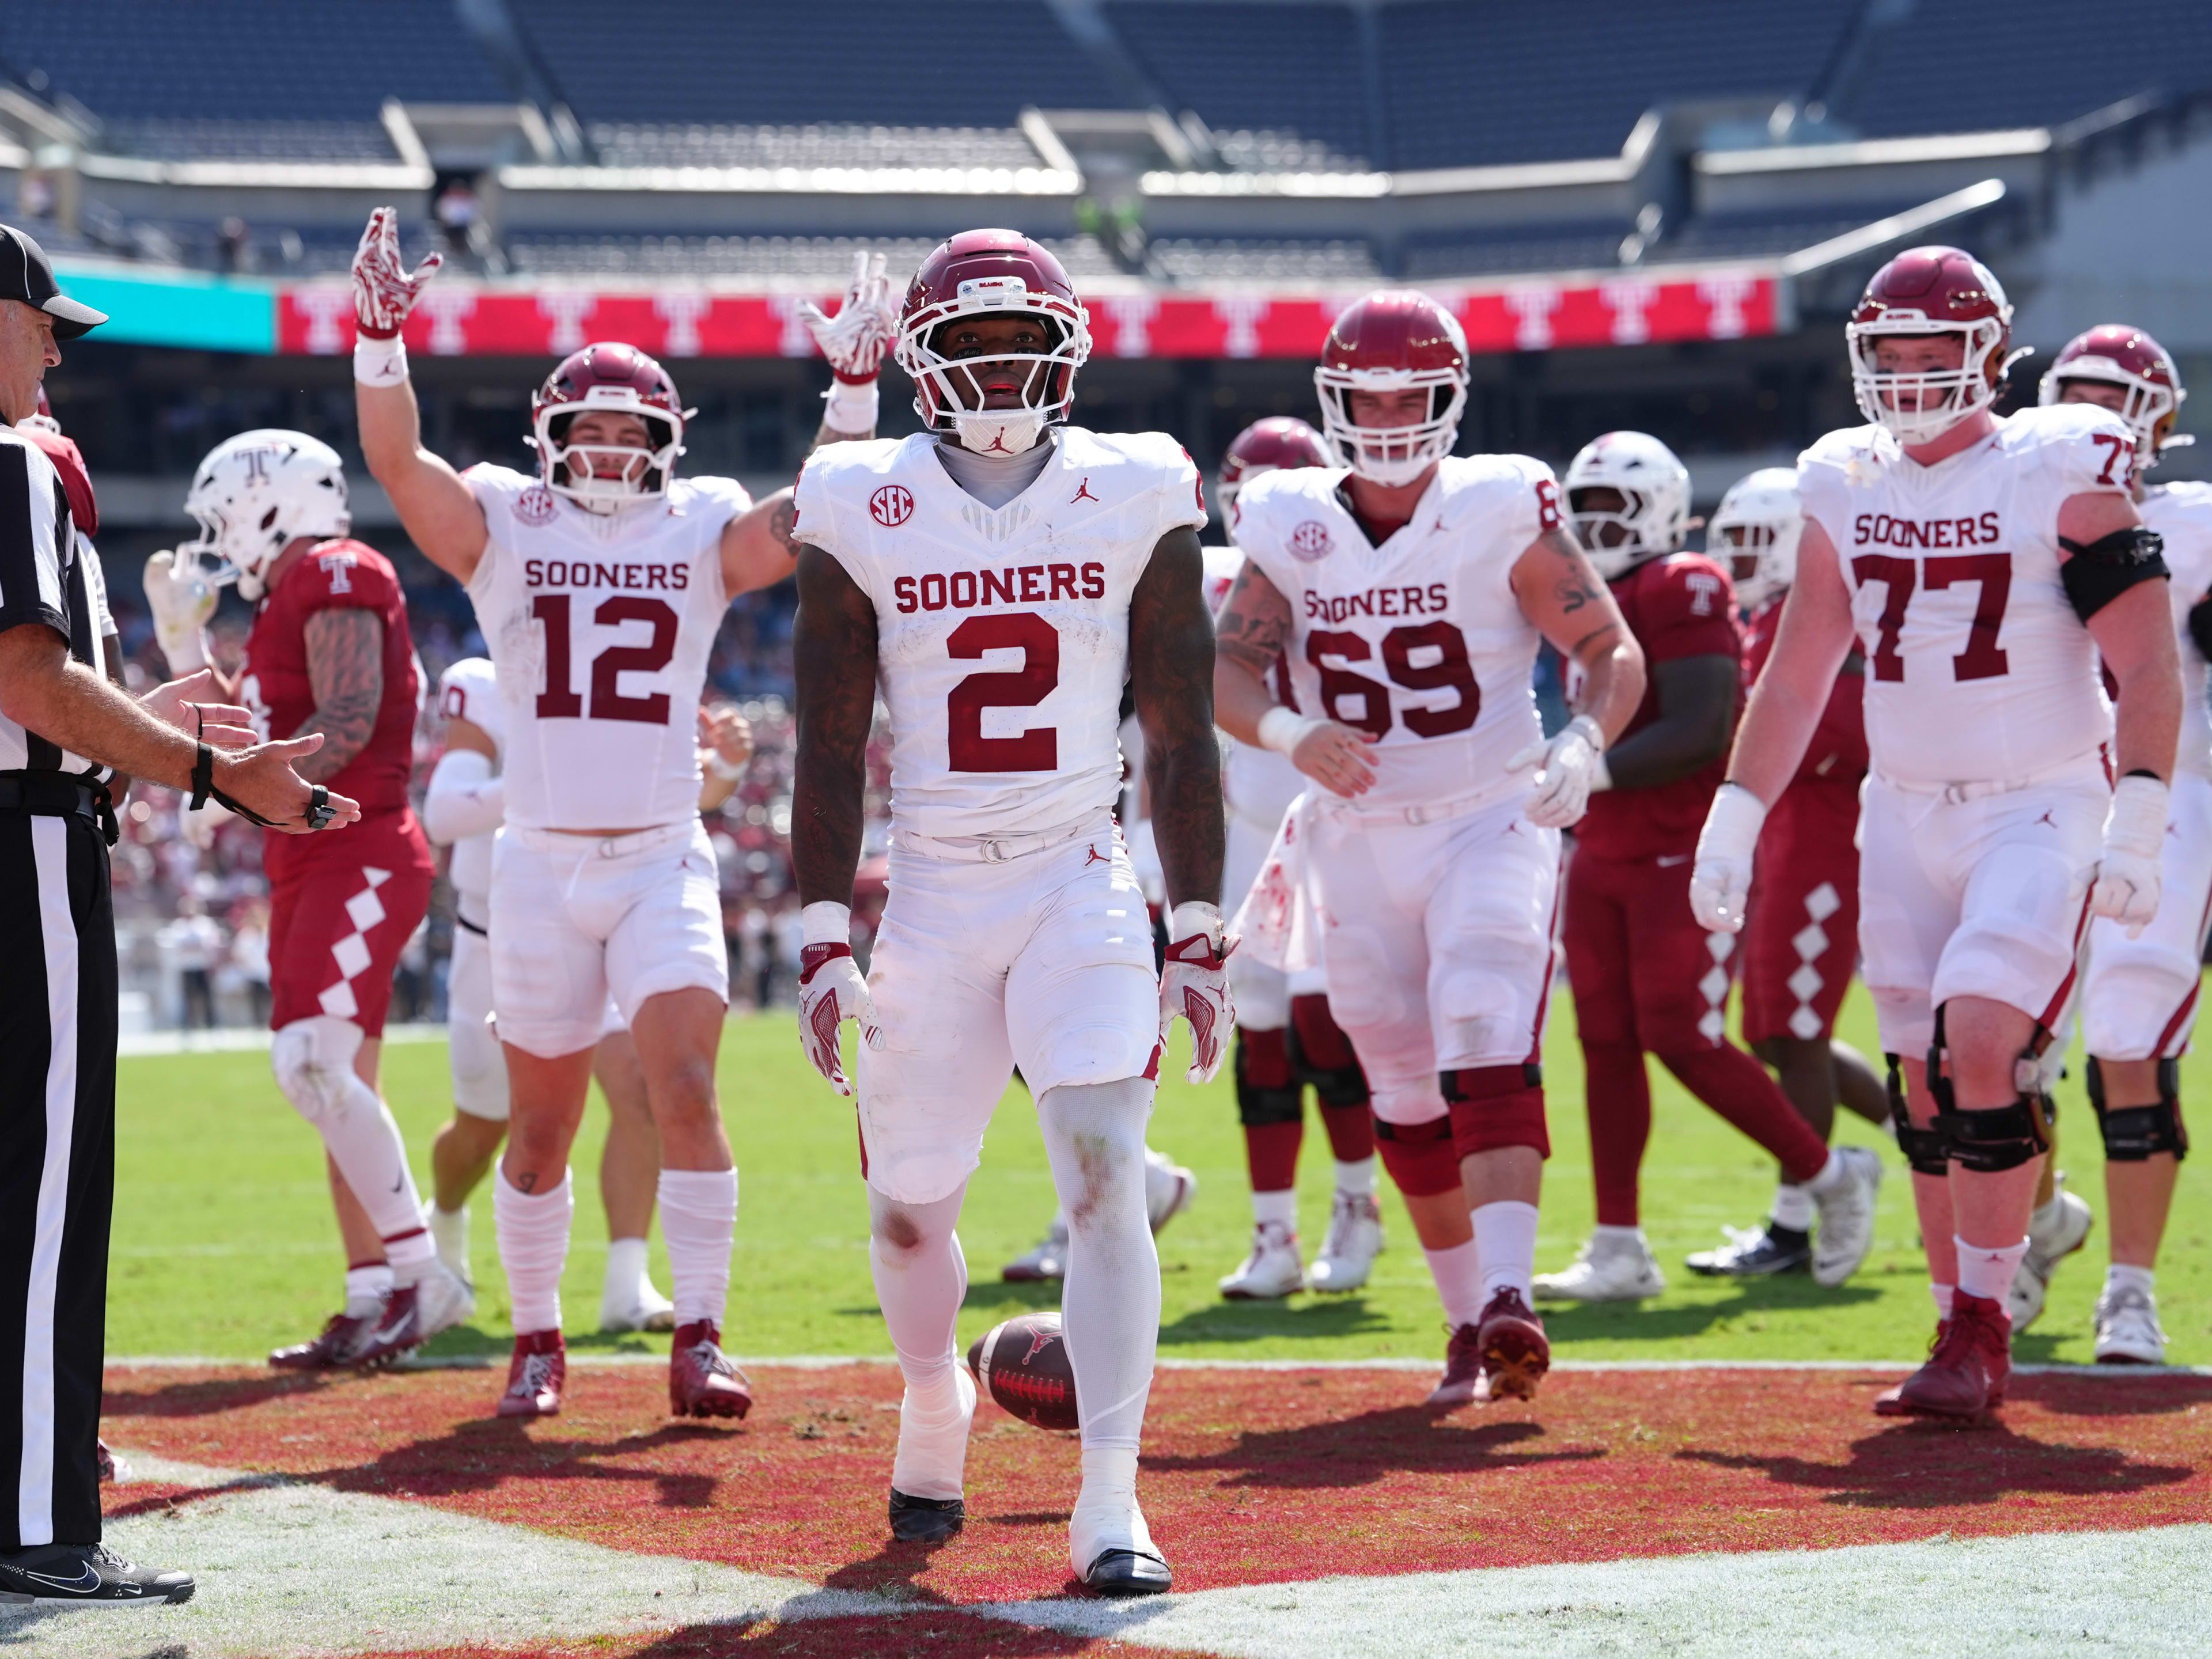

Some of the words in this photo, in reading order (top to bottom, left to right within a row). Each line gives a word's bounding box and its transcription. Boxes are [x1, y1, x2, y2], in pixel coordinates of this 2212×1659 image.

[234, 447, 277, 489] T
[521, 488, 552, 518] SEC
[871, 486, 912, 525] SEC
[1536, 479, 1564, 529] 6
[1294, 522, 1327, 552] SEC
[1855, 512, 1998, 548] SOONERS
[319, 552, 358, 594] T
[525, 560, 689, 590] SOONERS
[895, 562, 1105, 613] SOONERS
[1685, 573, 1720, 615] T
[1305, 584, 1448, 624] SOONERS
[1851, 553, 2012, 683] 77
[532, 594, 679, 726] 12
[946, 612, 1059, 773] 2
[1306, 619, 1482, 744] 69
